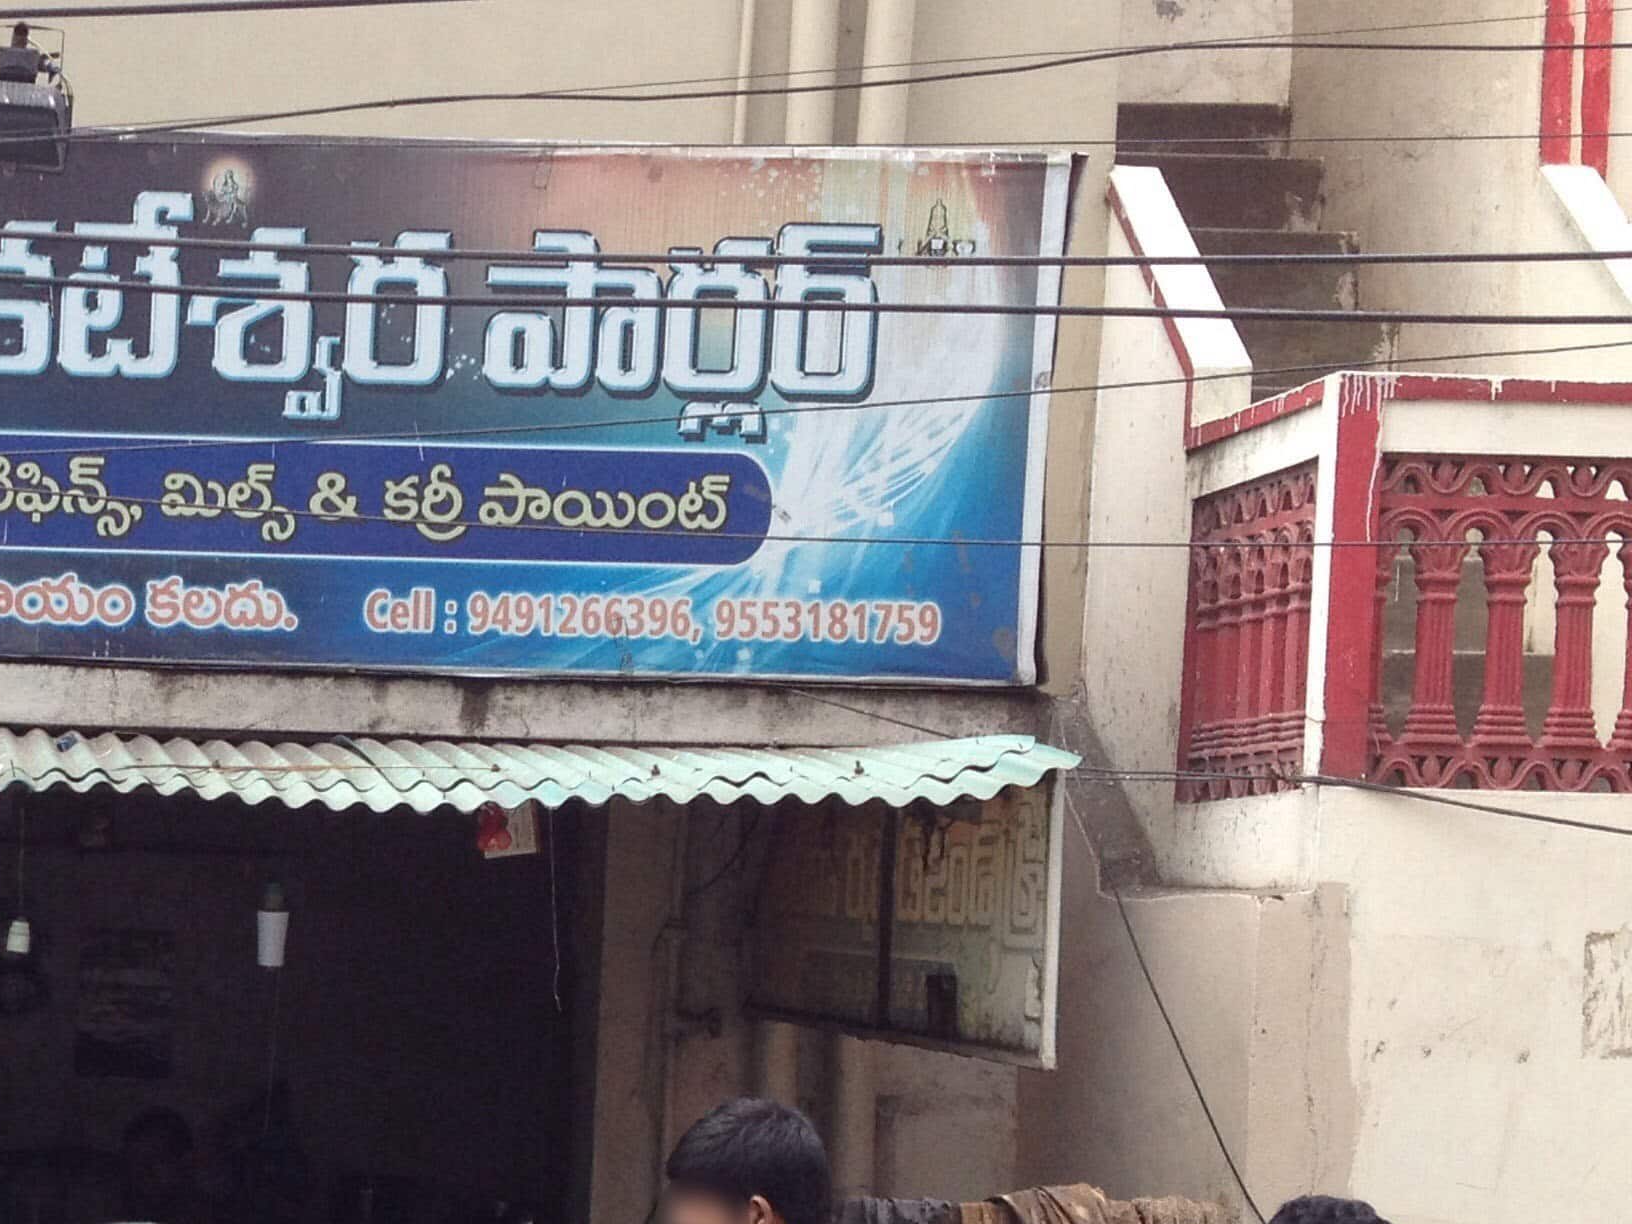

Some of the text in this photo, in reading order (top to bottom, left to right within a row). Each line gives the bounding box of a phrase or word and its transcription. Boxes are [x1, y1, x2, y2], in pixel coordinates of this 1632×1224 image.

[482, 222, 884, 444] పార్లర్
[309, 472, 359, 521] &
[477, 473, 730, 532] పాయింట్
[145, 576, 299, 632] కలదు.
[365, 590, 434, 634] Cell
[468, 592, 703, 643] 9491266396,
[714, 599, 942, 645] 9553181759
